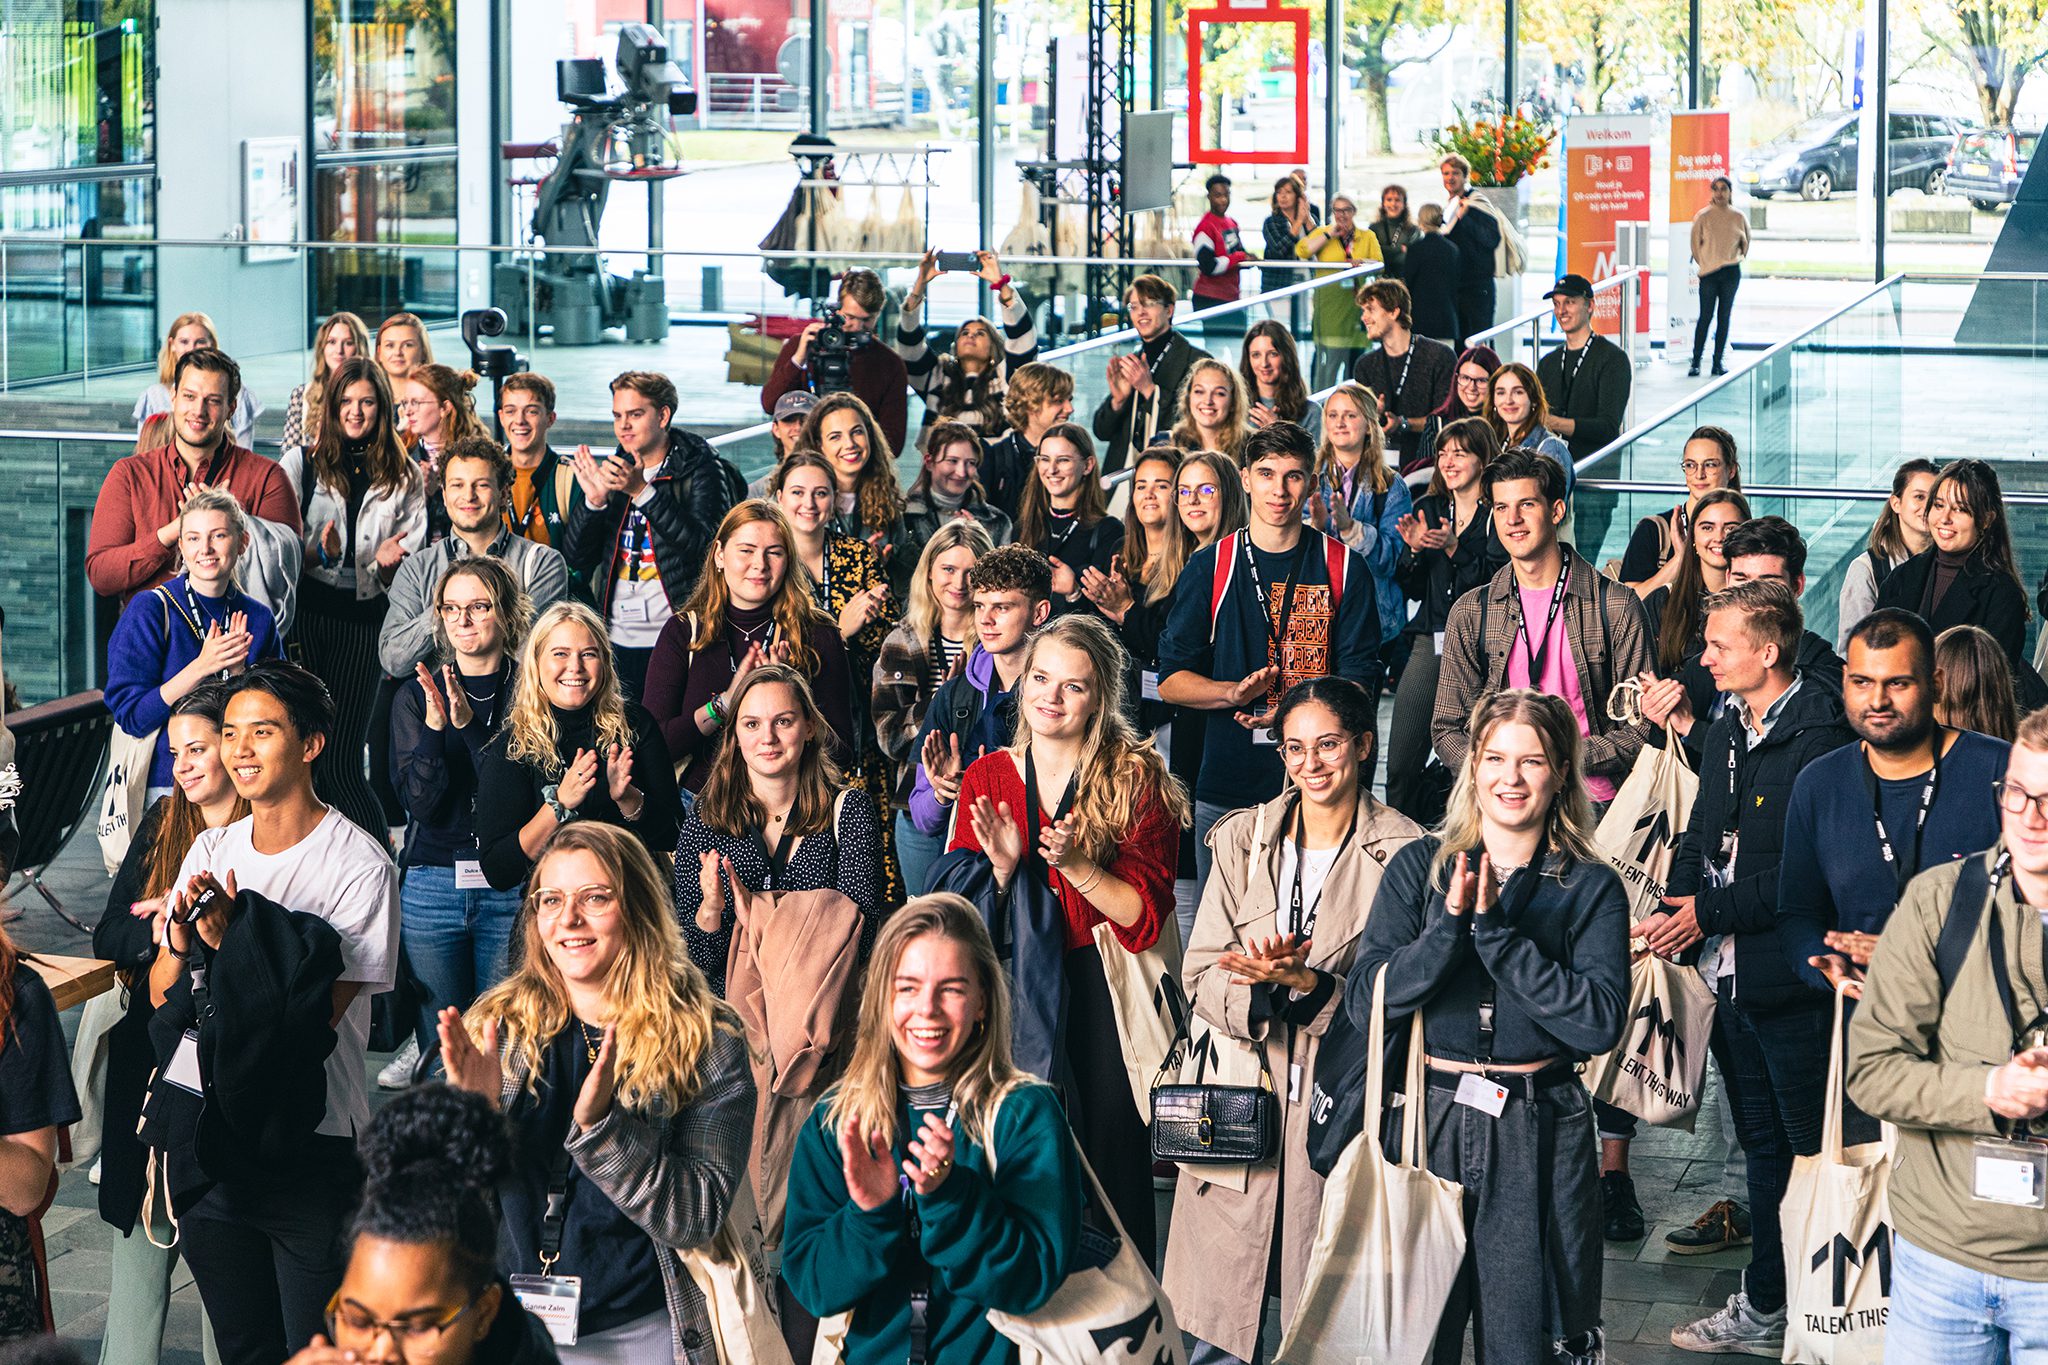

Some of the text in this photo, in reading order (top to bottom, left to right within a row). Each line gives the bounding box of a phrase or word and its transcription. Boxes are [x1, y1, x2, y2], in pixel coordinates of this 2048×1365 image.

[1586, 128, 1632, 140] Welkom
[1678, 152, 1722, 168] Dag voor de
[1600, 202, 1609, 210] de
[1610, 201, 1629, 210] hand
[1646, 877, 1666, 899] THIS
[1645, 1070, 1666, 1097] THIS
[1666, 1088, 1691, 1109] WAY
[1805, 1307, 1889, 1334] TALENT THIS
